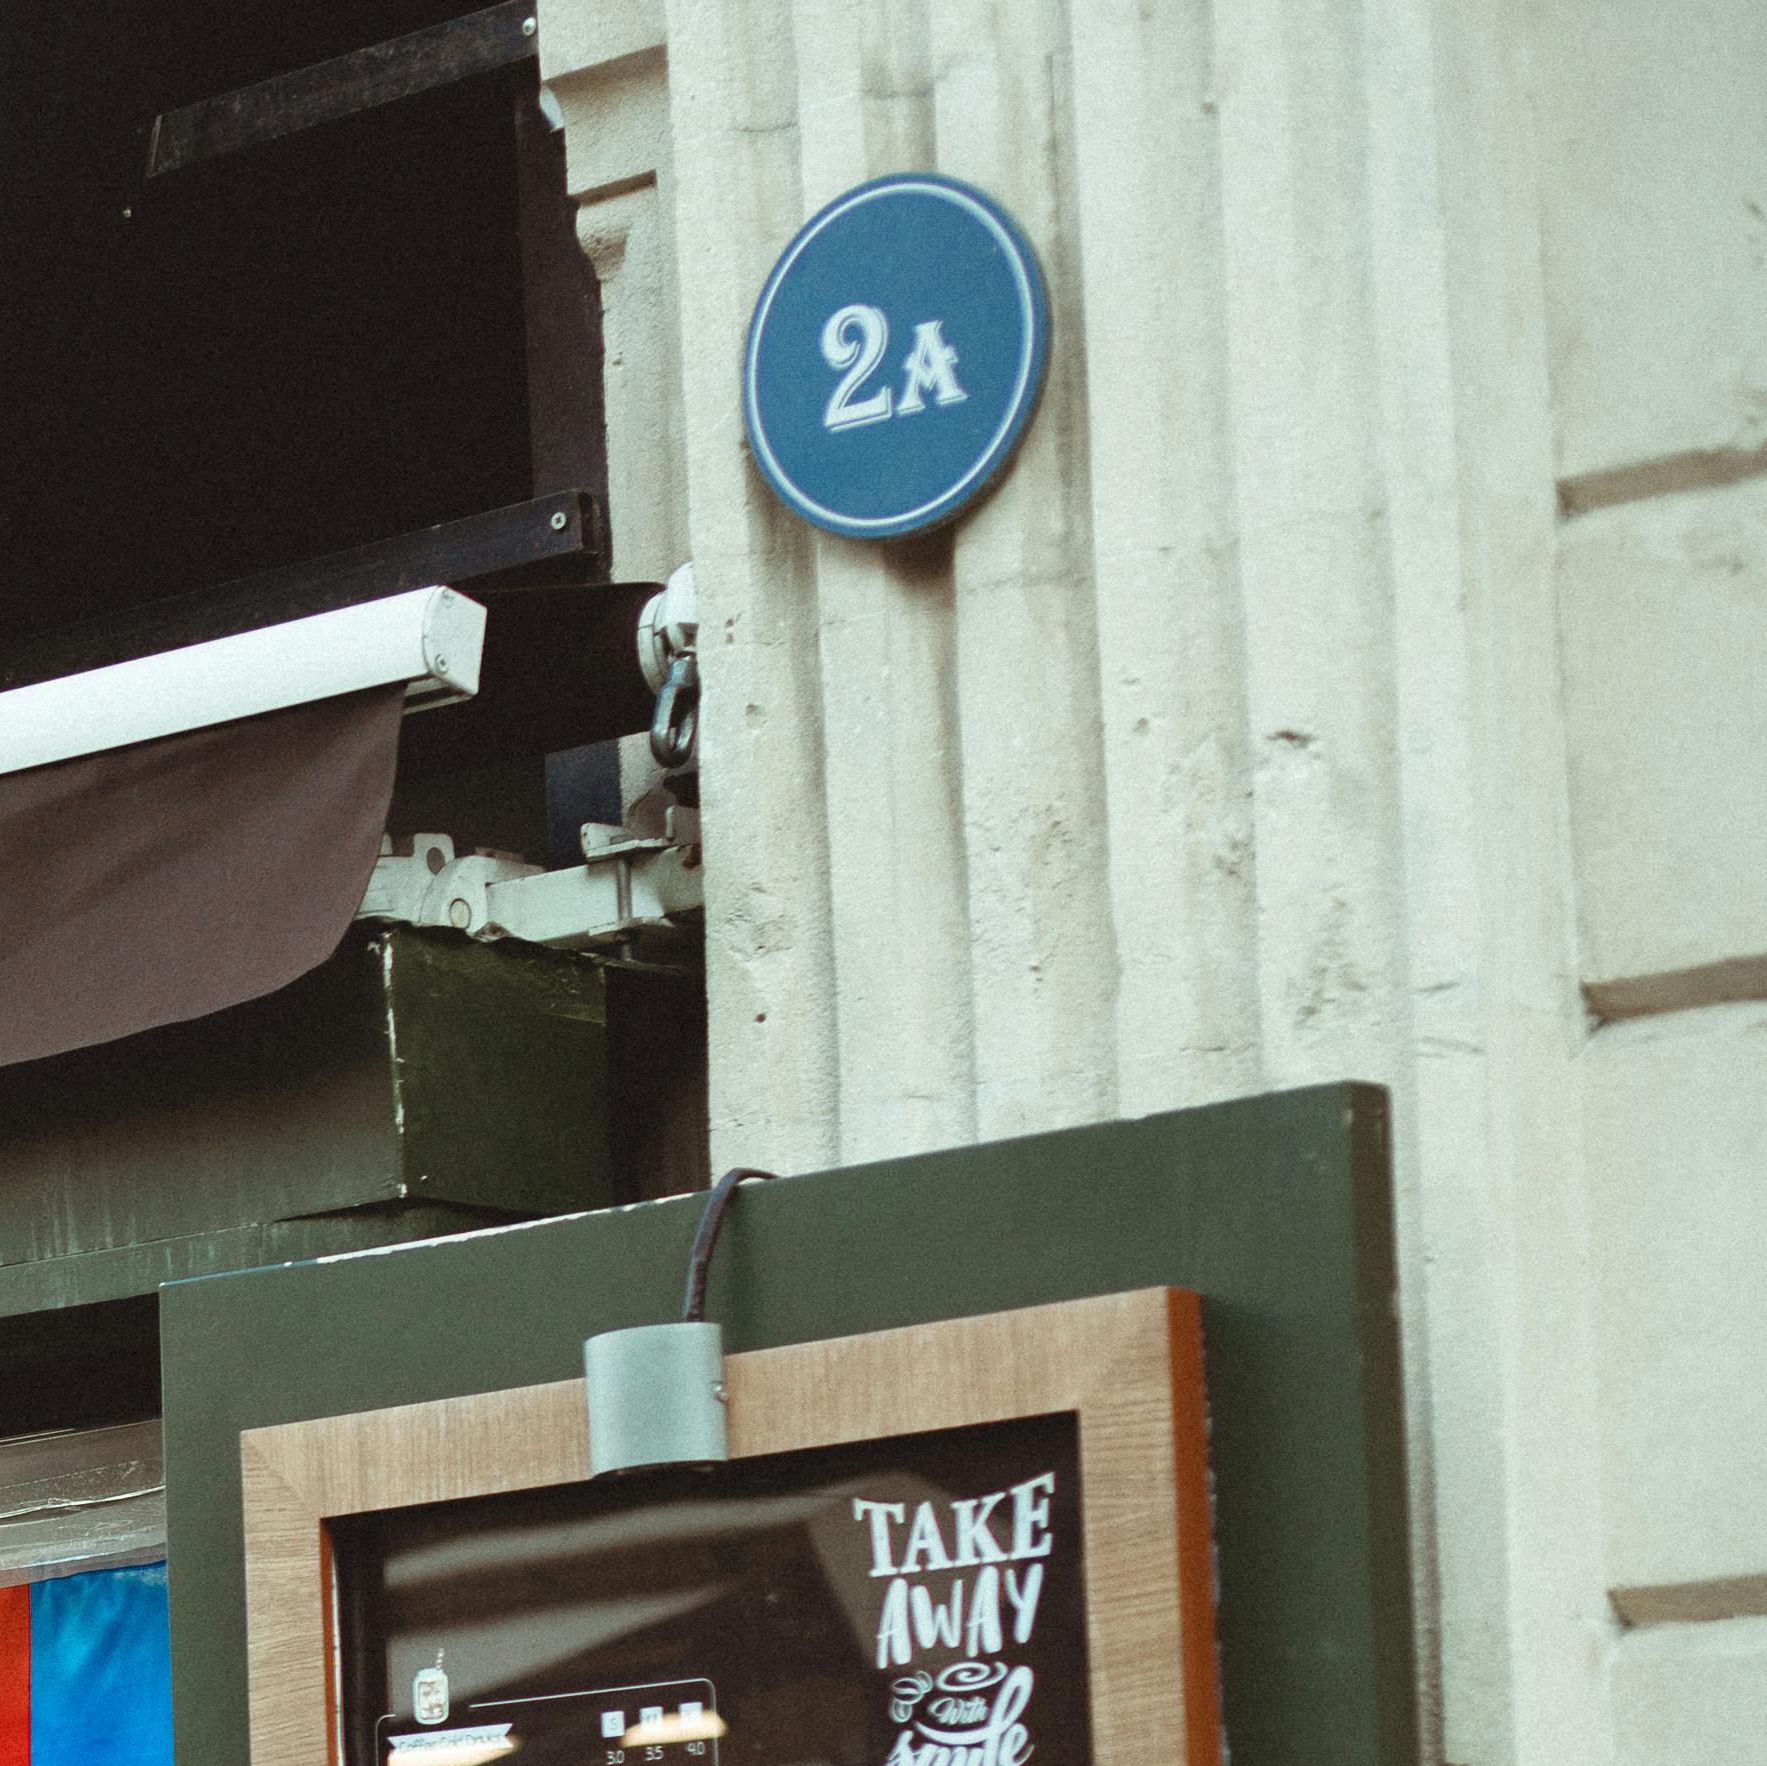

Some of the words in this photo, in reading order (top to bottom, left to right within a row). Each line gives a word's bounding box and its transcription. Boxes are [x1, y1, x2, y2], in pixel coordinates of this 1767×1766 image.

[821, 305, 967, 433] 2A
[853, 1472, 1055, 1577] TAKE
[877, 1563, 1043, 1669] AWAY
[928, 1697, 988, 1725] With
